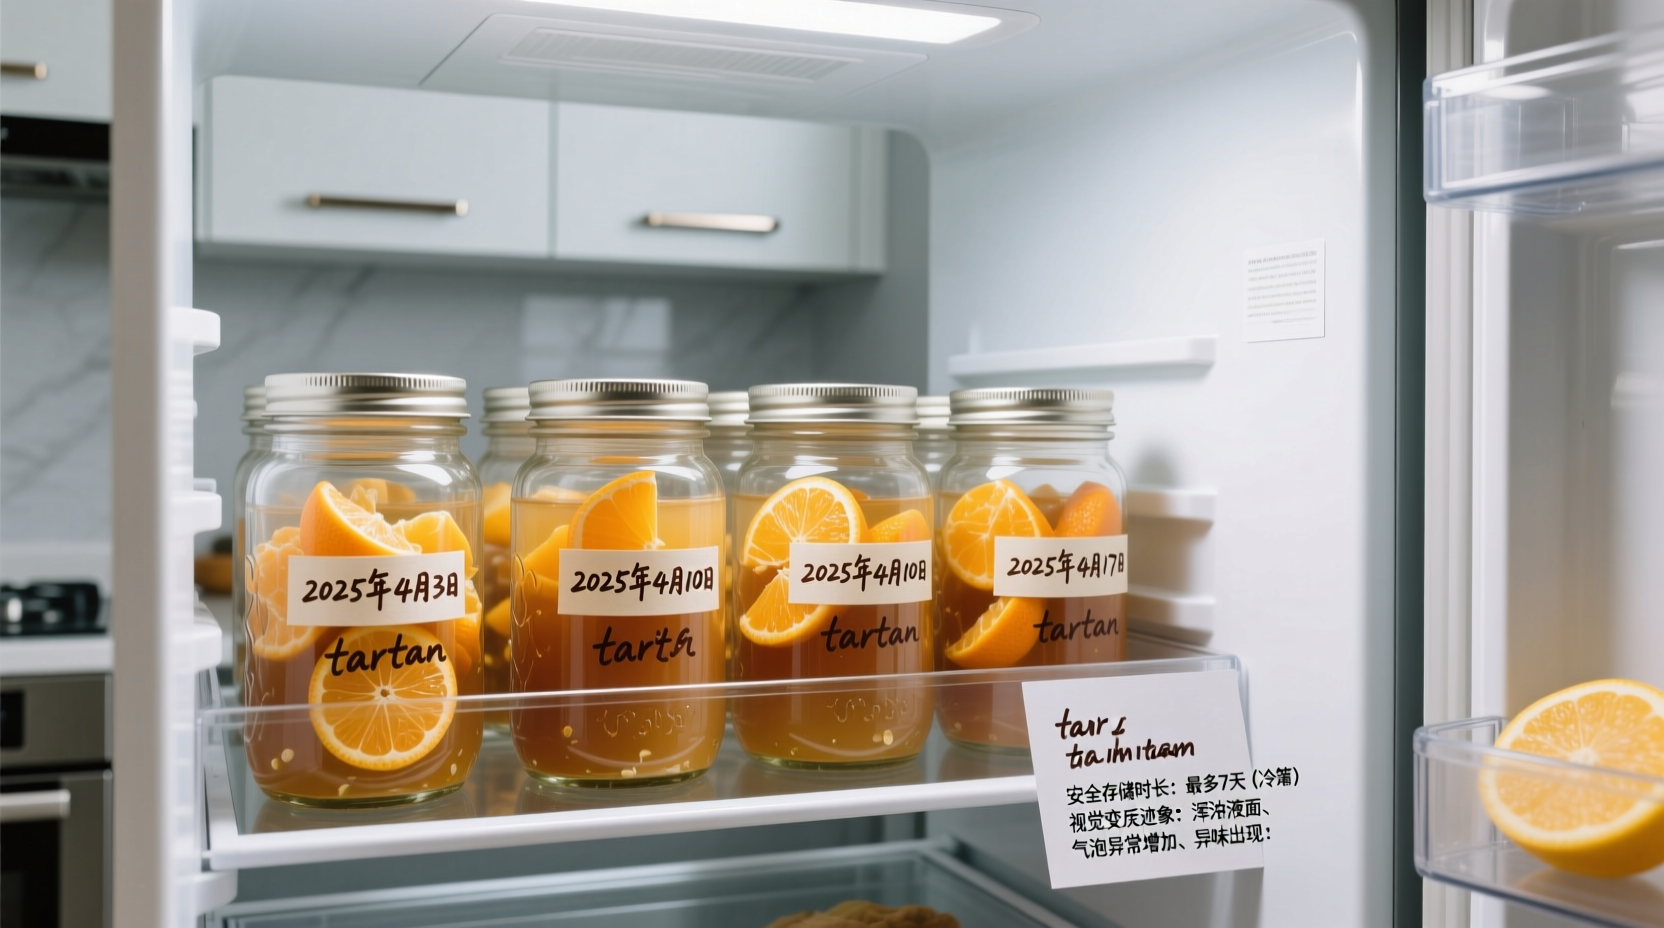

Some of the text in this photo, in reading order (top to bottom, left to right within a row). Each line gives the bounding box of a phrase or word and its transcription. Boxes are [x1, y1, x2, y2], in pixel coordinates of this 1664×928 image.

[570, 562, 714, 602] 2025年4月10日
[801, 553, 927, 592] 2025年4月10日
[1007, 548, 1125, 585] 2025年4月17日
[302, 568, 458, 612] 2025年4月3日
[820, 615, 920, 653] tartan
[1033, 609, 1119, 645] tartan
[324, 633, 447, 677] tartan
